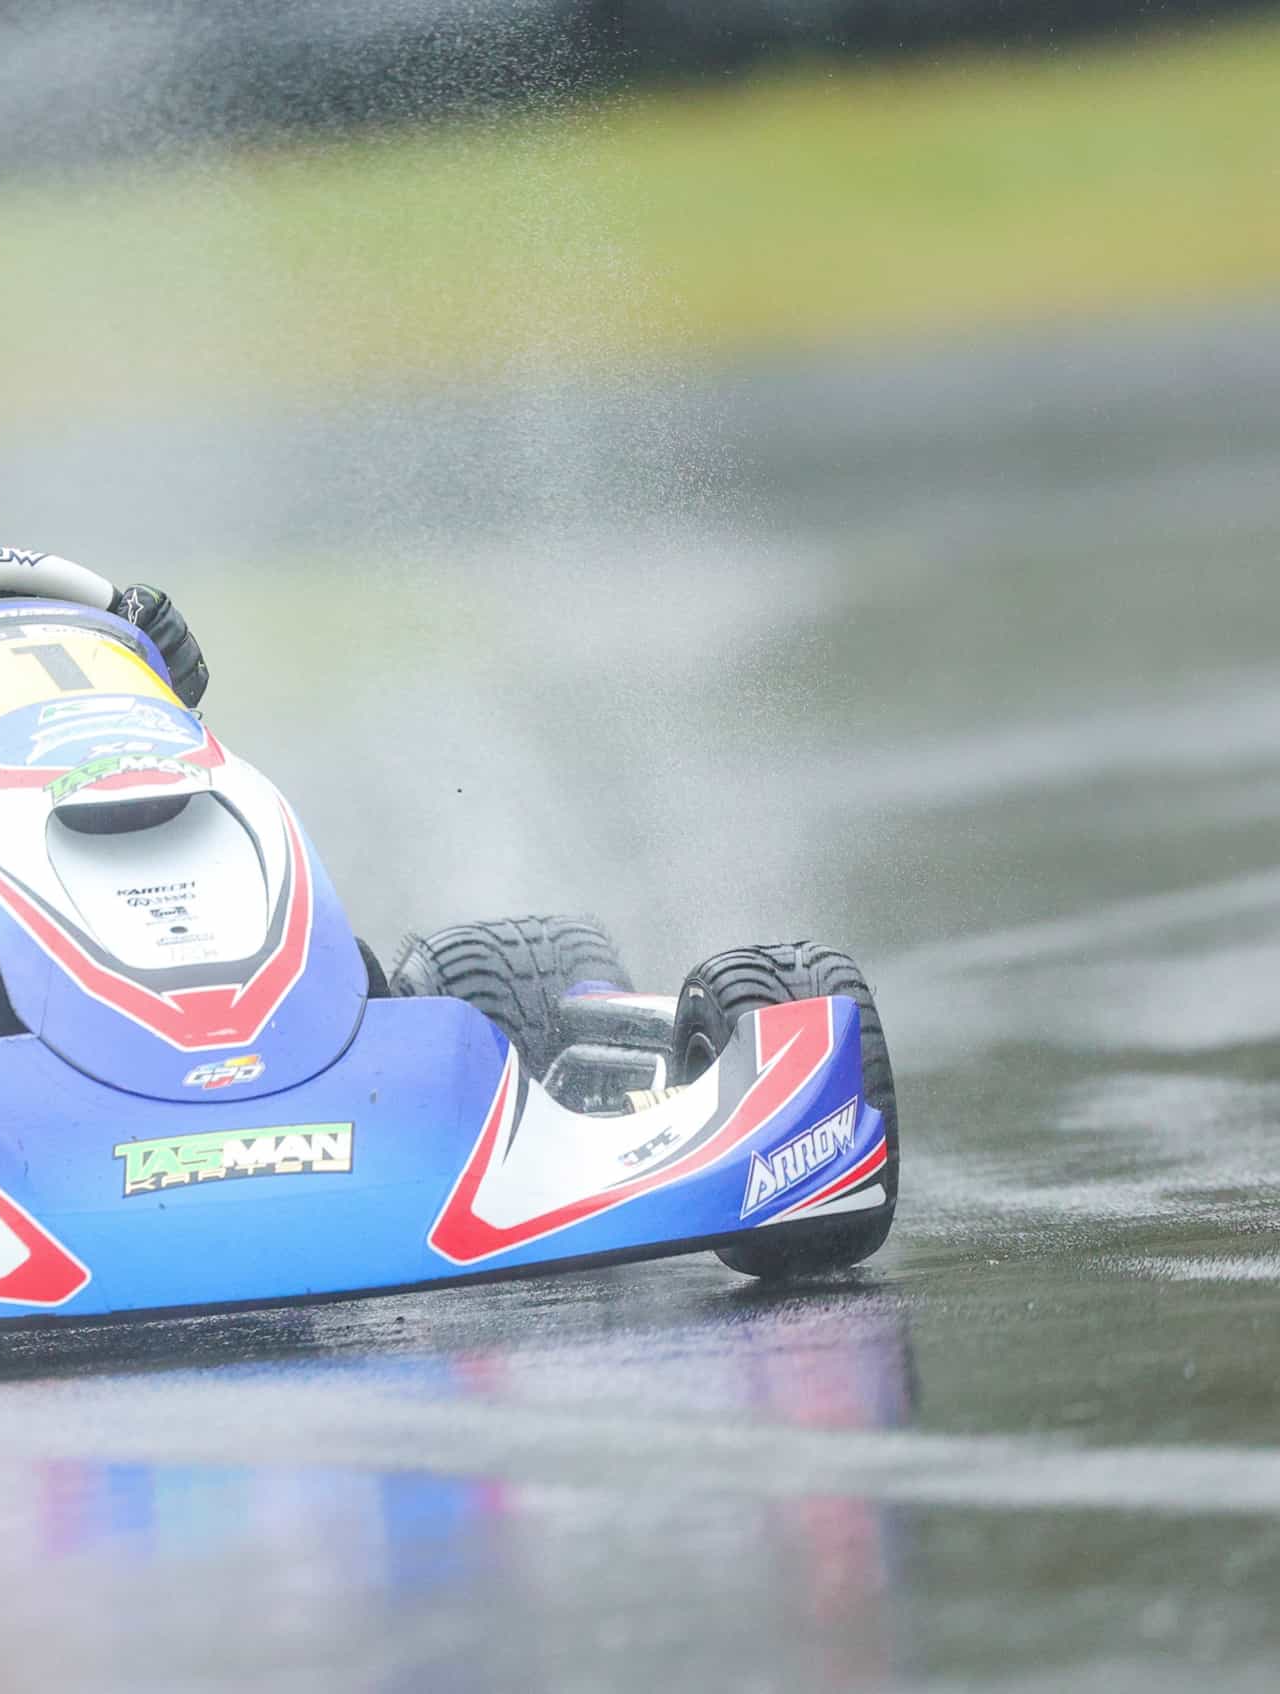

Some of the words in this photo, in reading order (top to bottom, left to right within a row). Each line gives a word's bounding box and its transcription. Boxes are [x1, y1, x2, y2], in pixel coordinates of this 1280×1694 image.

[10, 643, 96, 691] 1
[114, 1123, 354, 1181] TASMAN
[740, 1094, 858, 1220] ARROW
